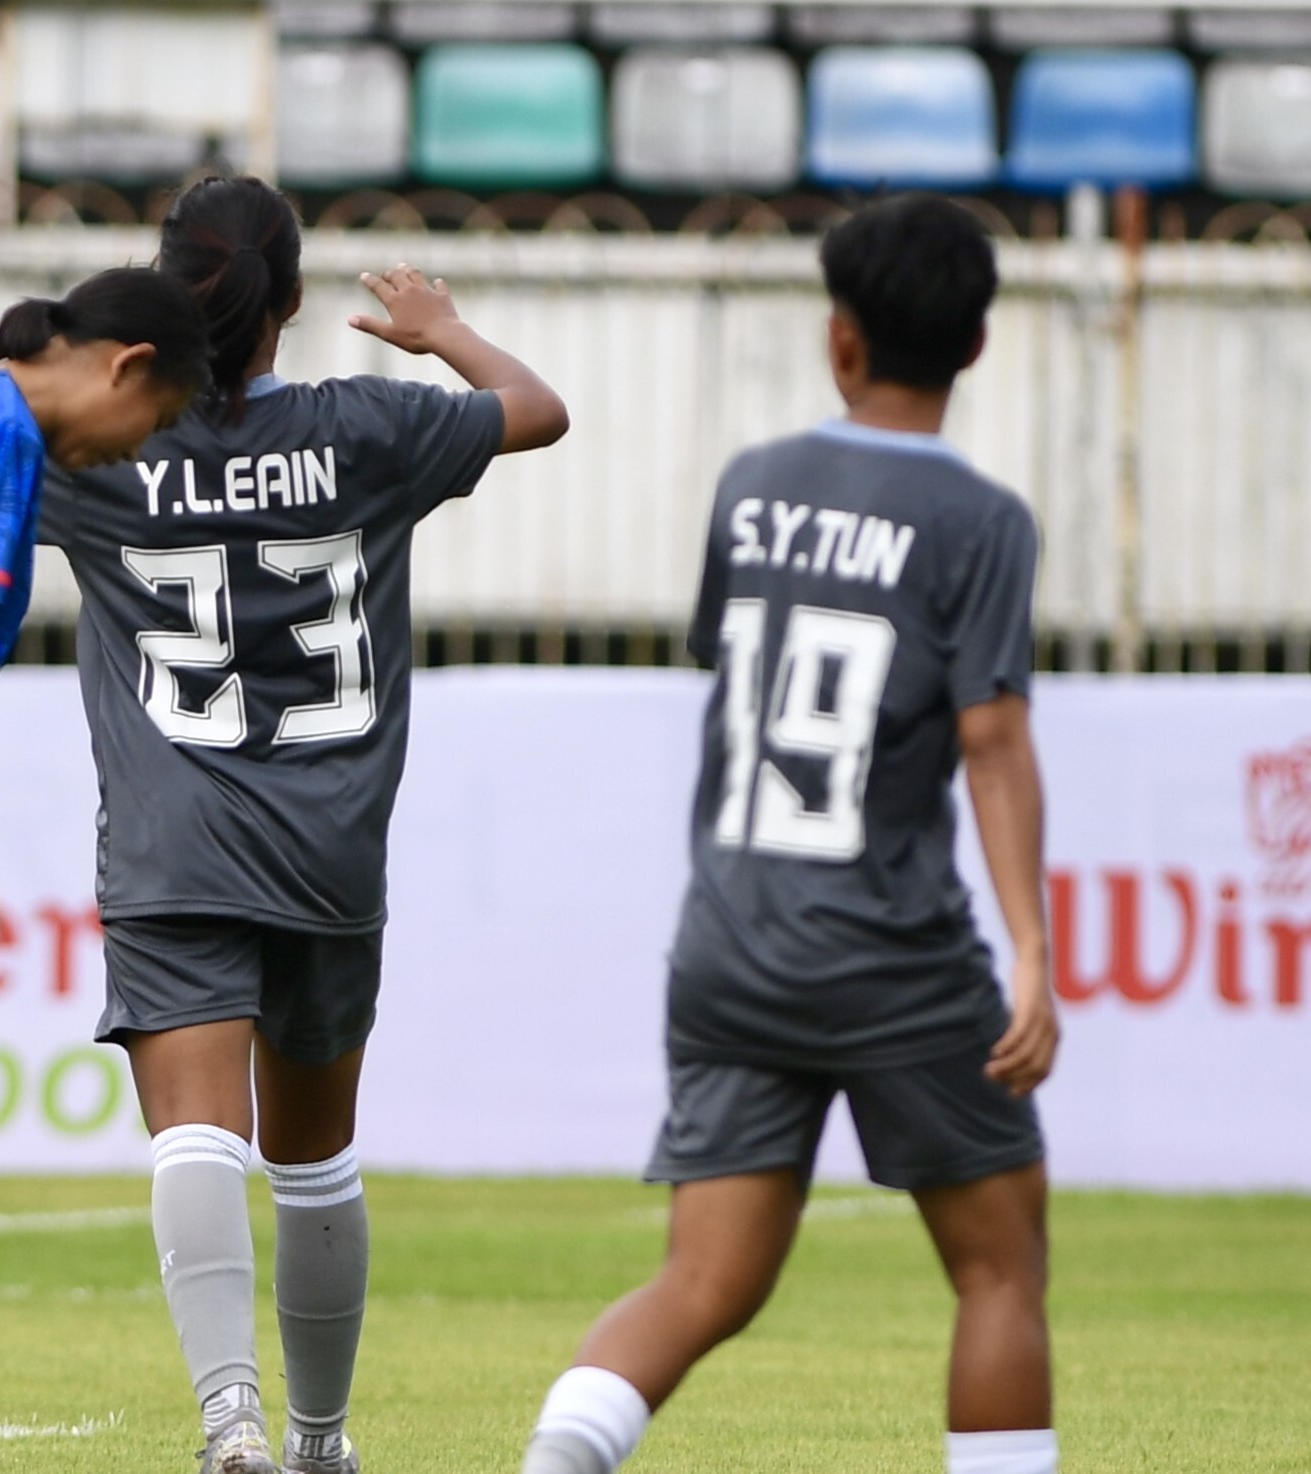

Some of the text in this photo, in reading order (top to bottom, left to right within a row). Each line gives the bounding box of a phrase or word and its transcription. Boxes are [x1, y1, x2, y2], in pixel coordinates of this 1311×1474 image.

[136, 446, 337, 515] Y.L.EAIN
[730, 498, 916, 589] S.Y.TUN
[121, 528, 377, 748] 23
[714, 597, 898, 863] 19
